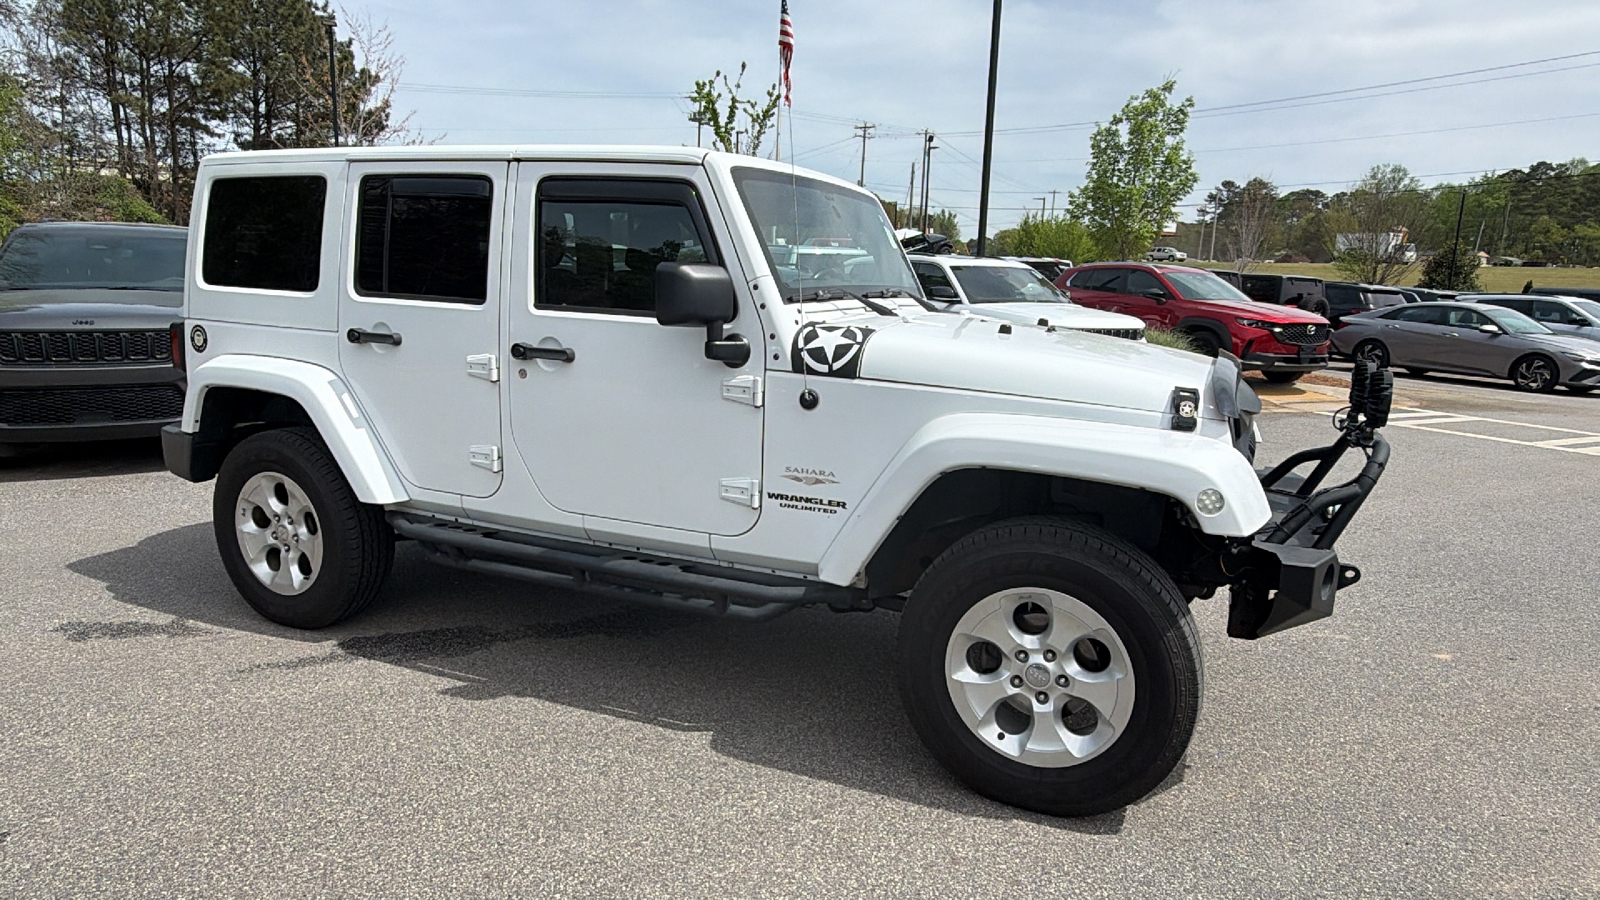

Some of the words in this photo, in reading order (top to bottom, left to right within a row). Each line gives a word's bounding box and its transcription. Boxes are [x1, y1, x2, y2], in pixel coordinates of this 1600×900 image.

[785, 466, 837, 478] SAHARA
[767, 492, 847, 509] WRANGLER
[780, 503, 837, 514] UNLIMITED
